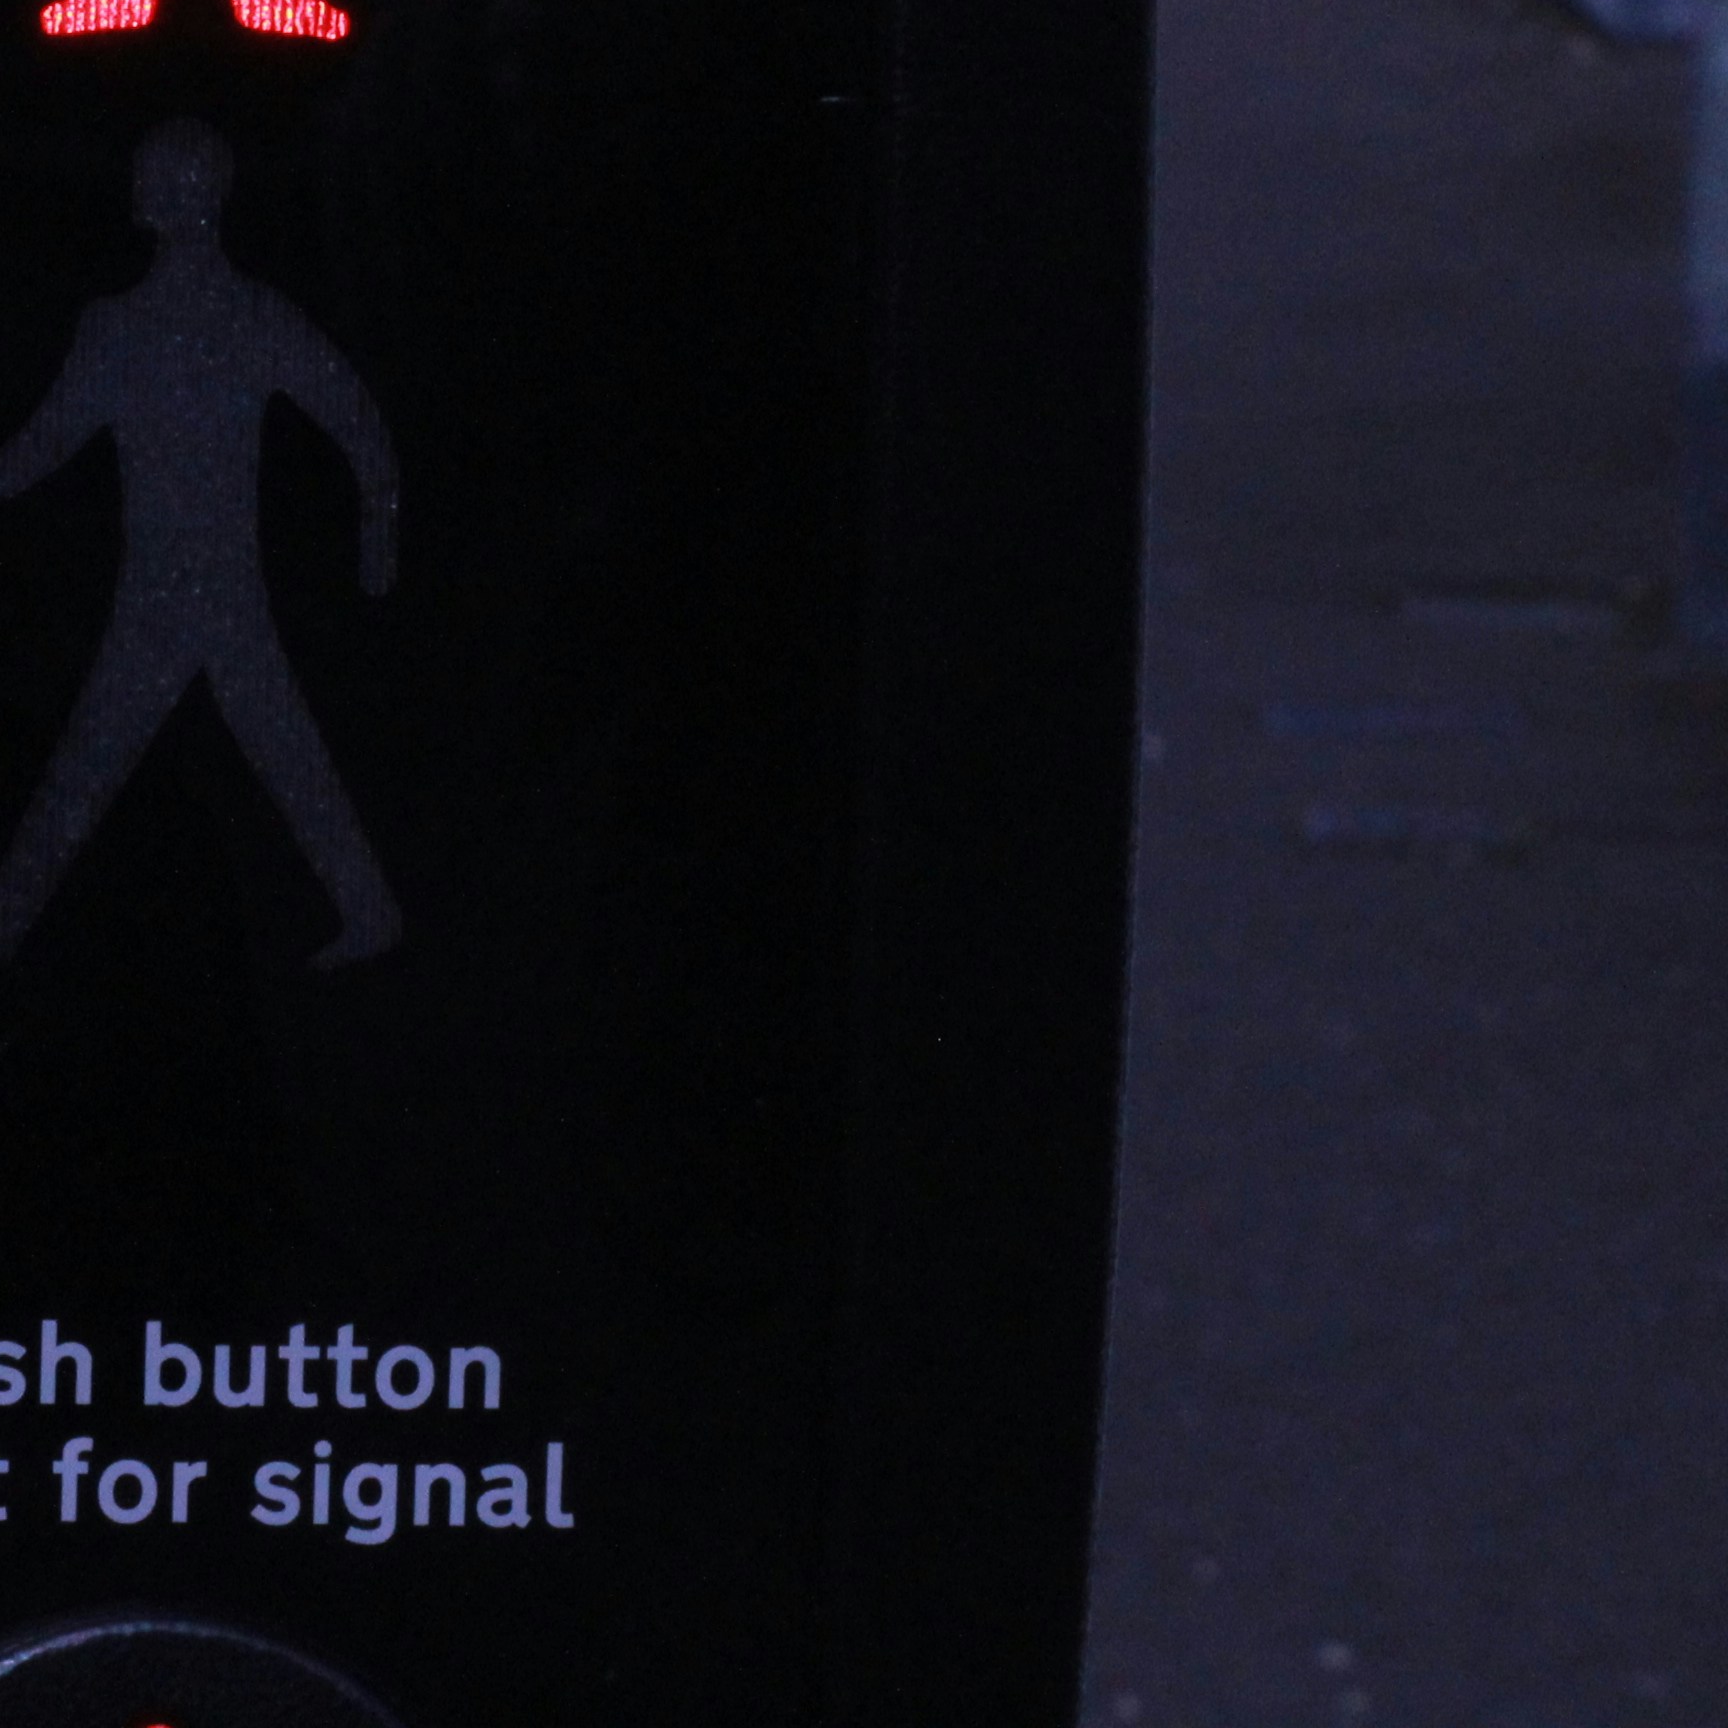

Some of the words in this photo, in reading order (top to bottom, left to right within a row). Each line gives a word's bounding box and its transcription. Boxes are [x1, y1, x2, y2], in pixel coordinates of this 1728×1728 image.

[143, 1319, 501, 1409] button
[52, 1436, 208, 1524] for
[250, 1440, 574, 1546] signal
